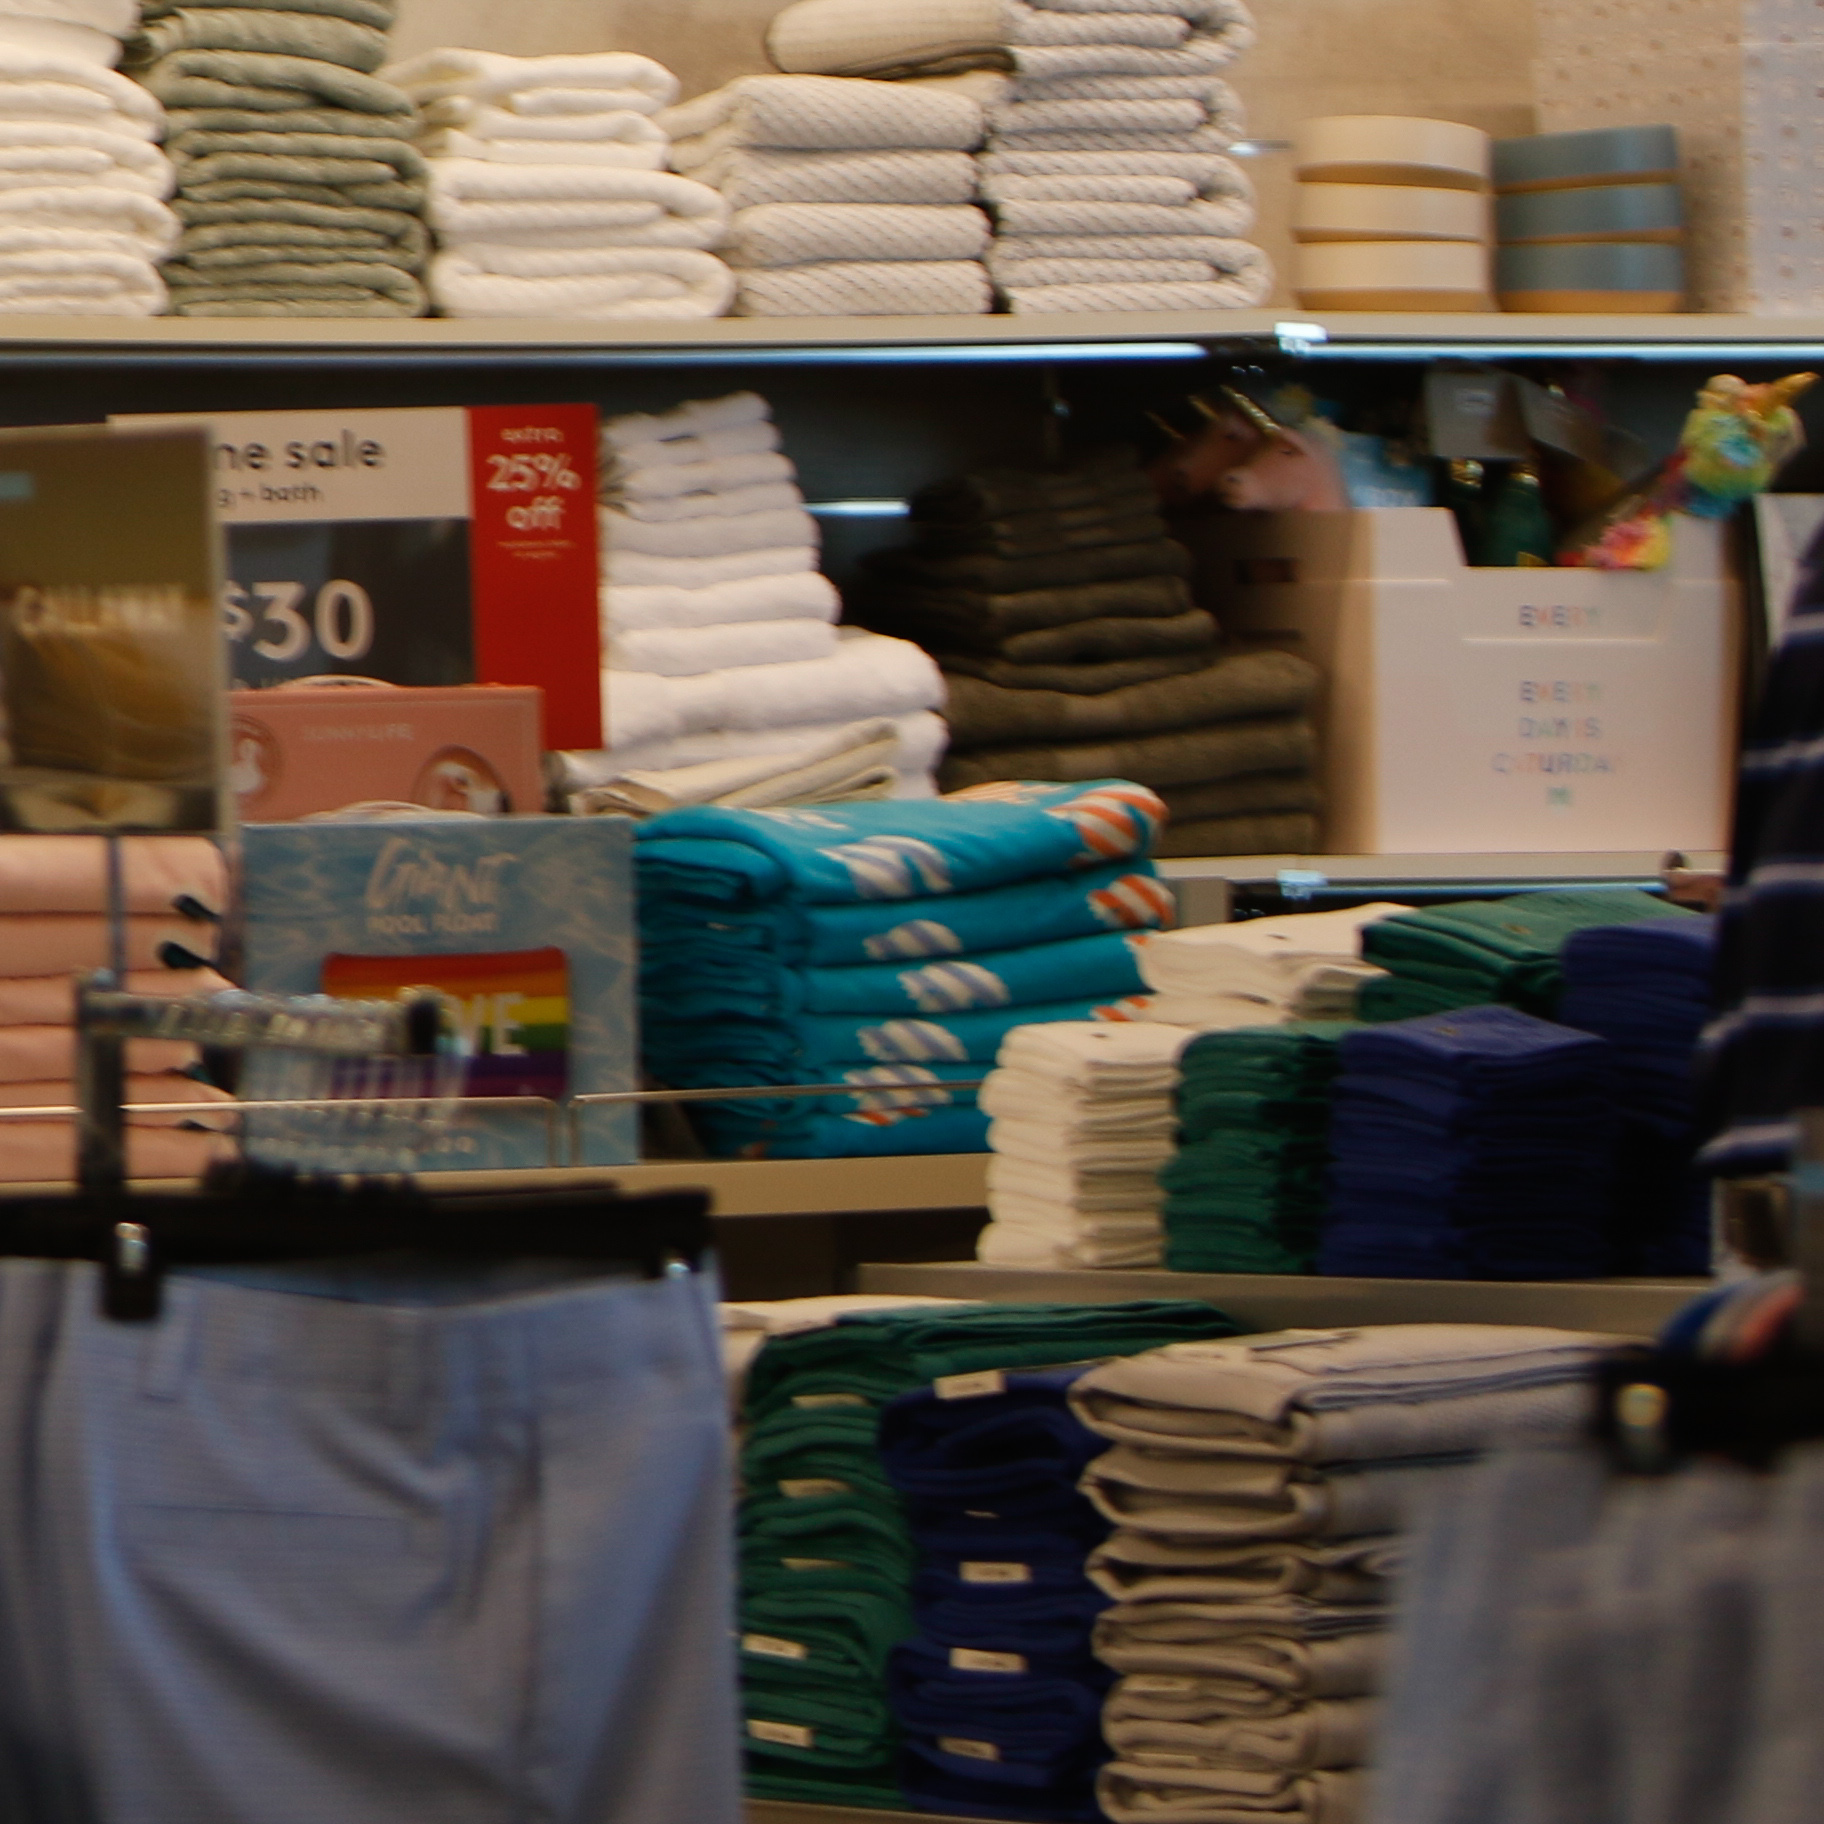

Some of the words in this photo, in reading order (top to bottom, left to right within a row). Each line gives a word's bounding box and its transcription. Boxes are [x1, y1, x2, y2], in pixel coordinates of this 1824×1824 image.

[285, 427, 386, 471] sale
[500, 426, 564, 444] extra
[485, 452, 583, 493] 25%
[260, 483, 324, 504] bath
[505, 495, 566, 531] off
[222, 578, 375, 662] $30
